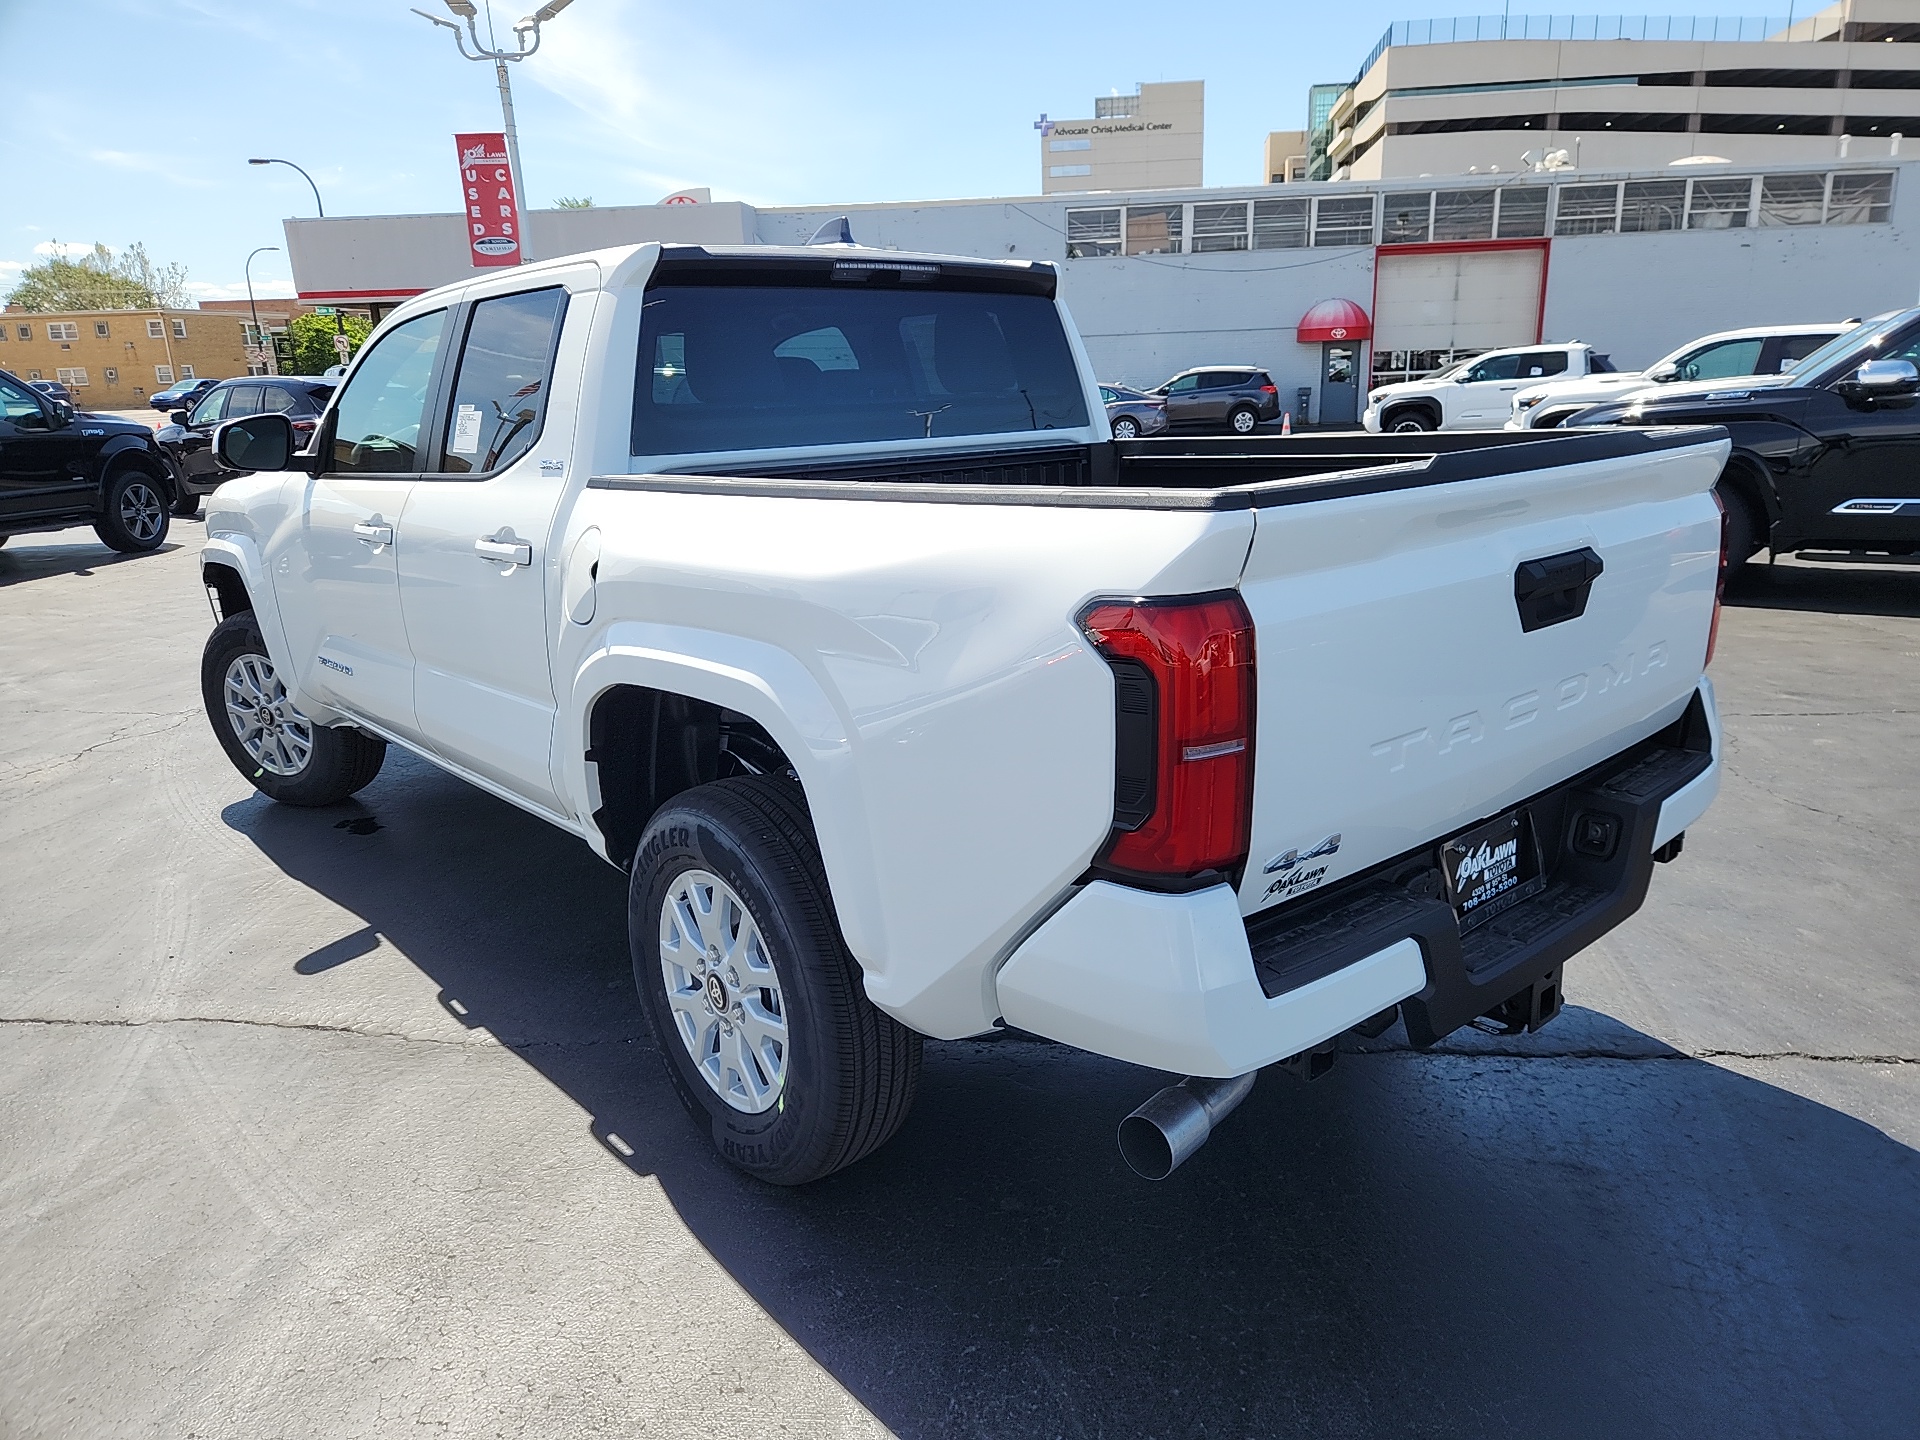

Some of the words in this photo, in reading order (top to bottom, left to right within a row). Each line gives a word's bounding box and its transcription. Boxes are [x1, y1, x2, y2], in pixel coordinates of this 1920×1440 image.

[1054, 127, 1089, 136] Advocate
[1091, 125, 1113, 134] Christ
[1114, 123, 1145, 133] Medical
[1147, 122, 1173, 131] Center
[465, 169, 486, 236] USED
[494, 168, 513, 235] CARS
[1370, 640, 1669, 773] TACOMA
[1486, 857, 1513, 880] TOYOTA
[1462, 875, 1518, 912] 708-423-5200
[1471, 884, 1485, 897] 4320
[1485, 882, 1492, 891] W
